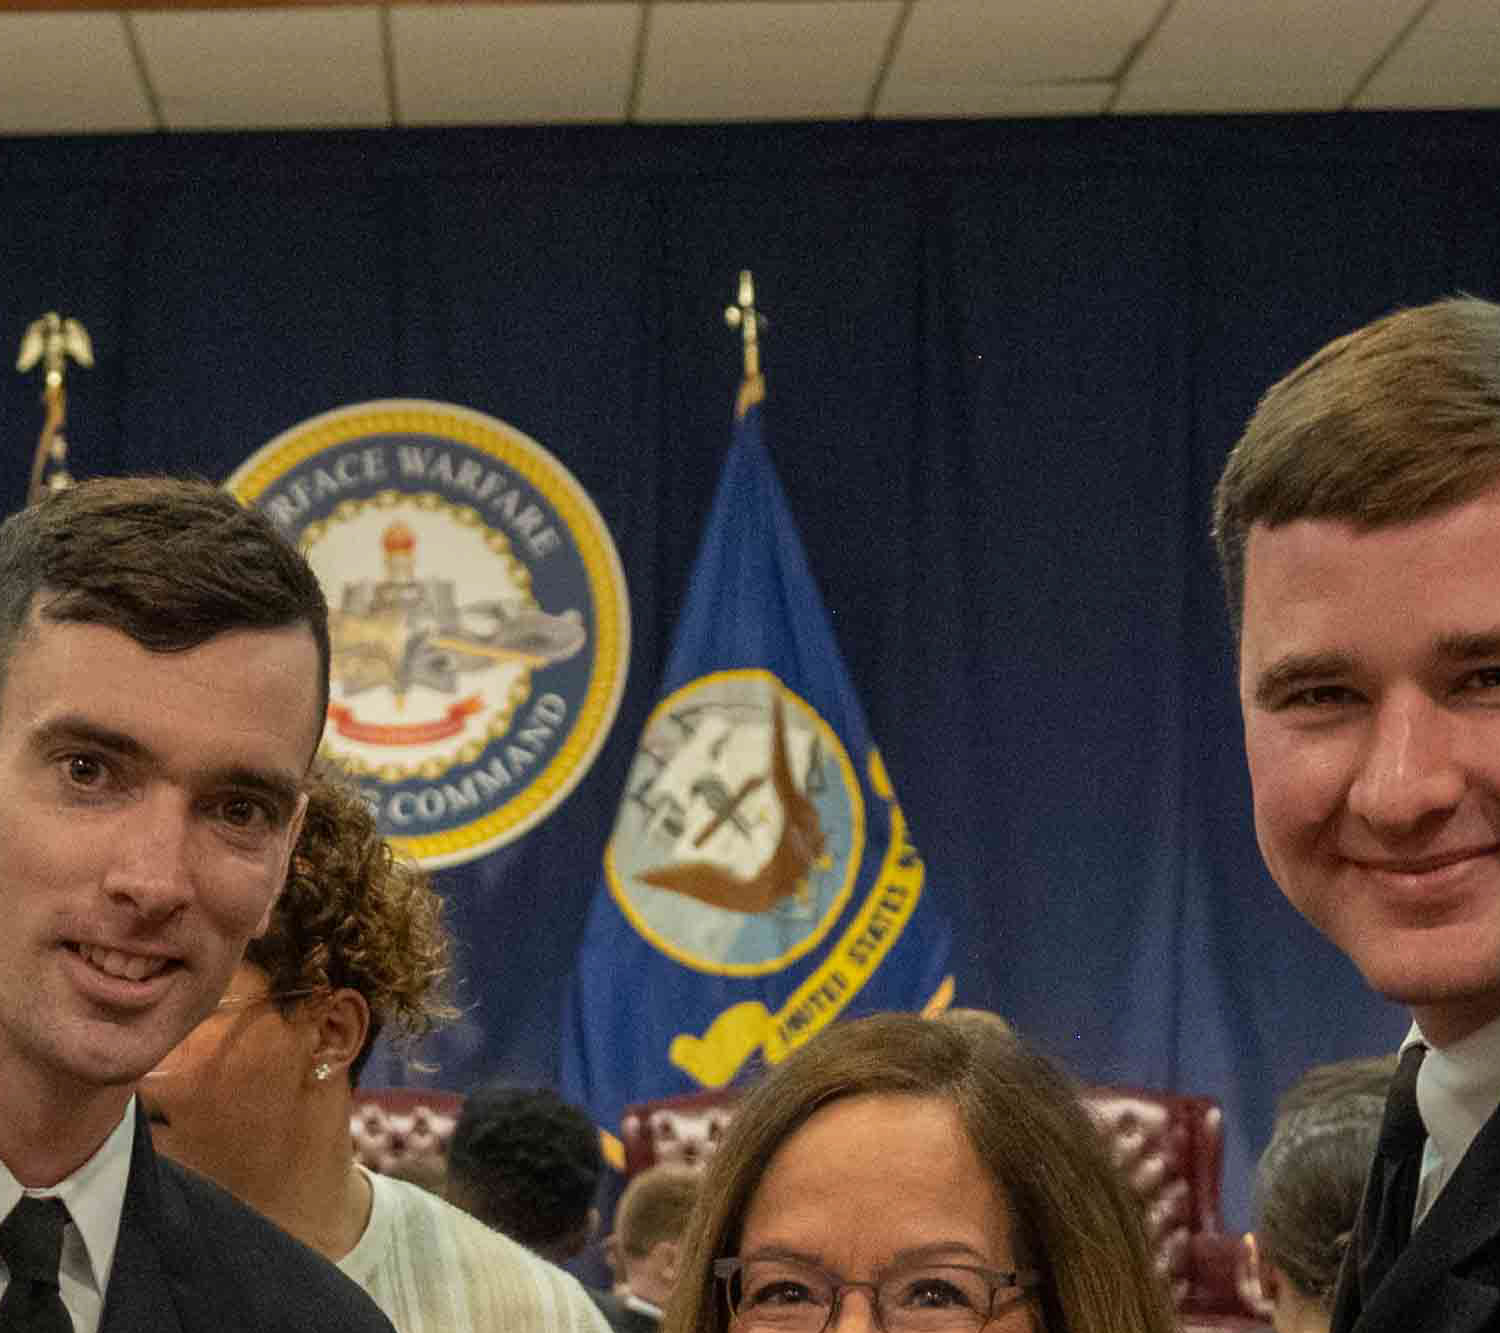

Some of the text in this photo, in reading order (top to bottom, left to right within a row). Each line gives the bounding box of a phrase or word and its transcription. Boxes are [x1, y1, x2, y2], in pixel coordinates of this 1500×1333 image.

[265, 446, 561, 558] RFACE WARFARE
[388, 692, 568, 826] COMMAND
